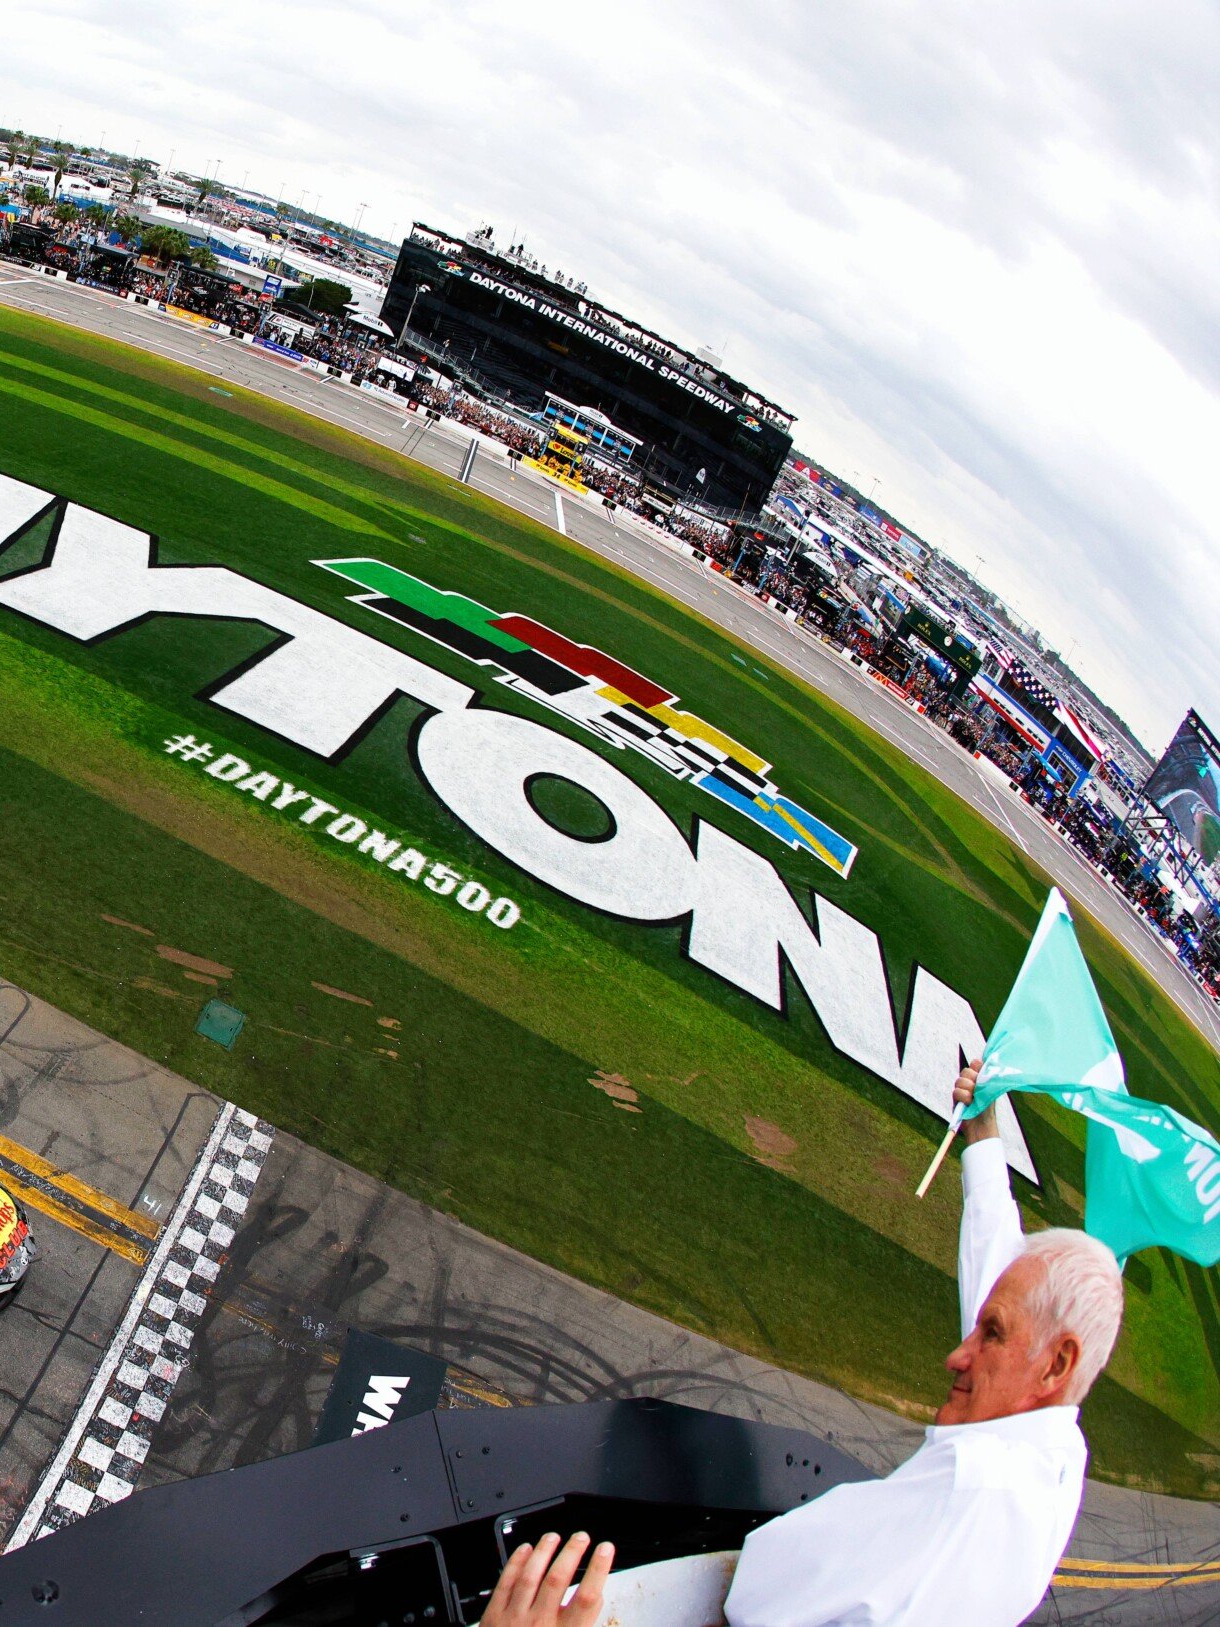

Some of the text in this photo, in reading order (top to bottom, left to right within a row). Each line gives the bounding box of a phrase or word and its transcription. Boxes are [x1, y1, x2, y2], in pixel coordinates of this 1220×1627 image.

[469, 272, 736, 414] DAYTONA INTERNATIONAL SPEEDWAY
[164, 734, 521, 929] #DAYTONA500
